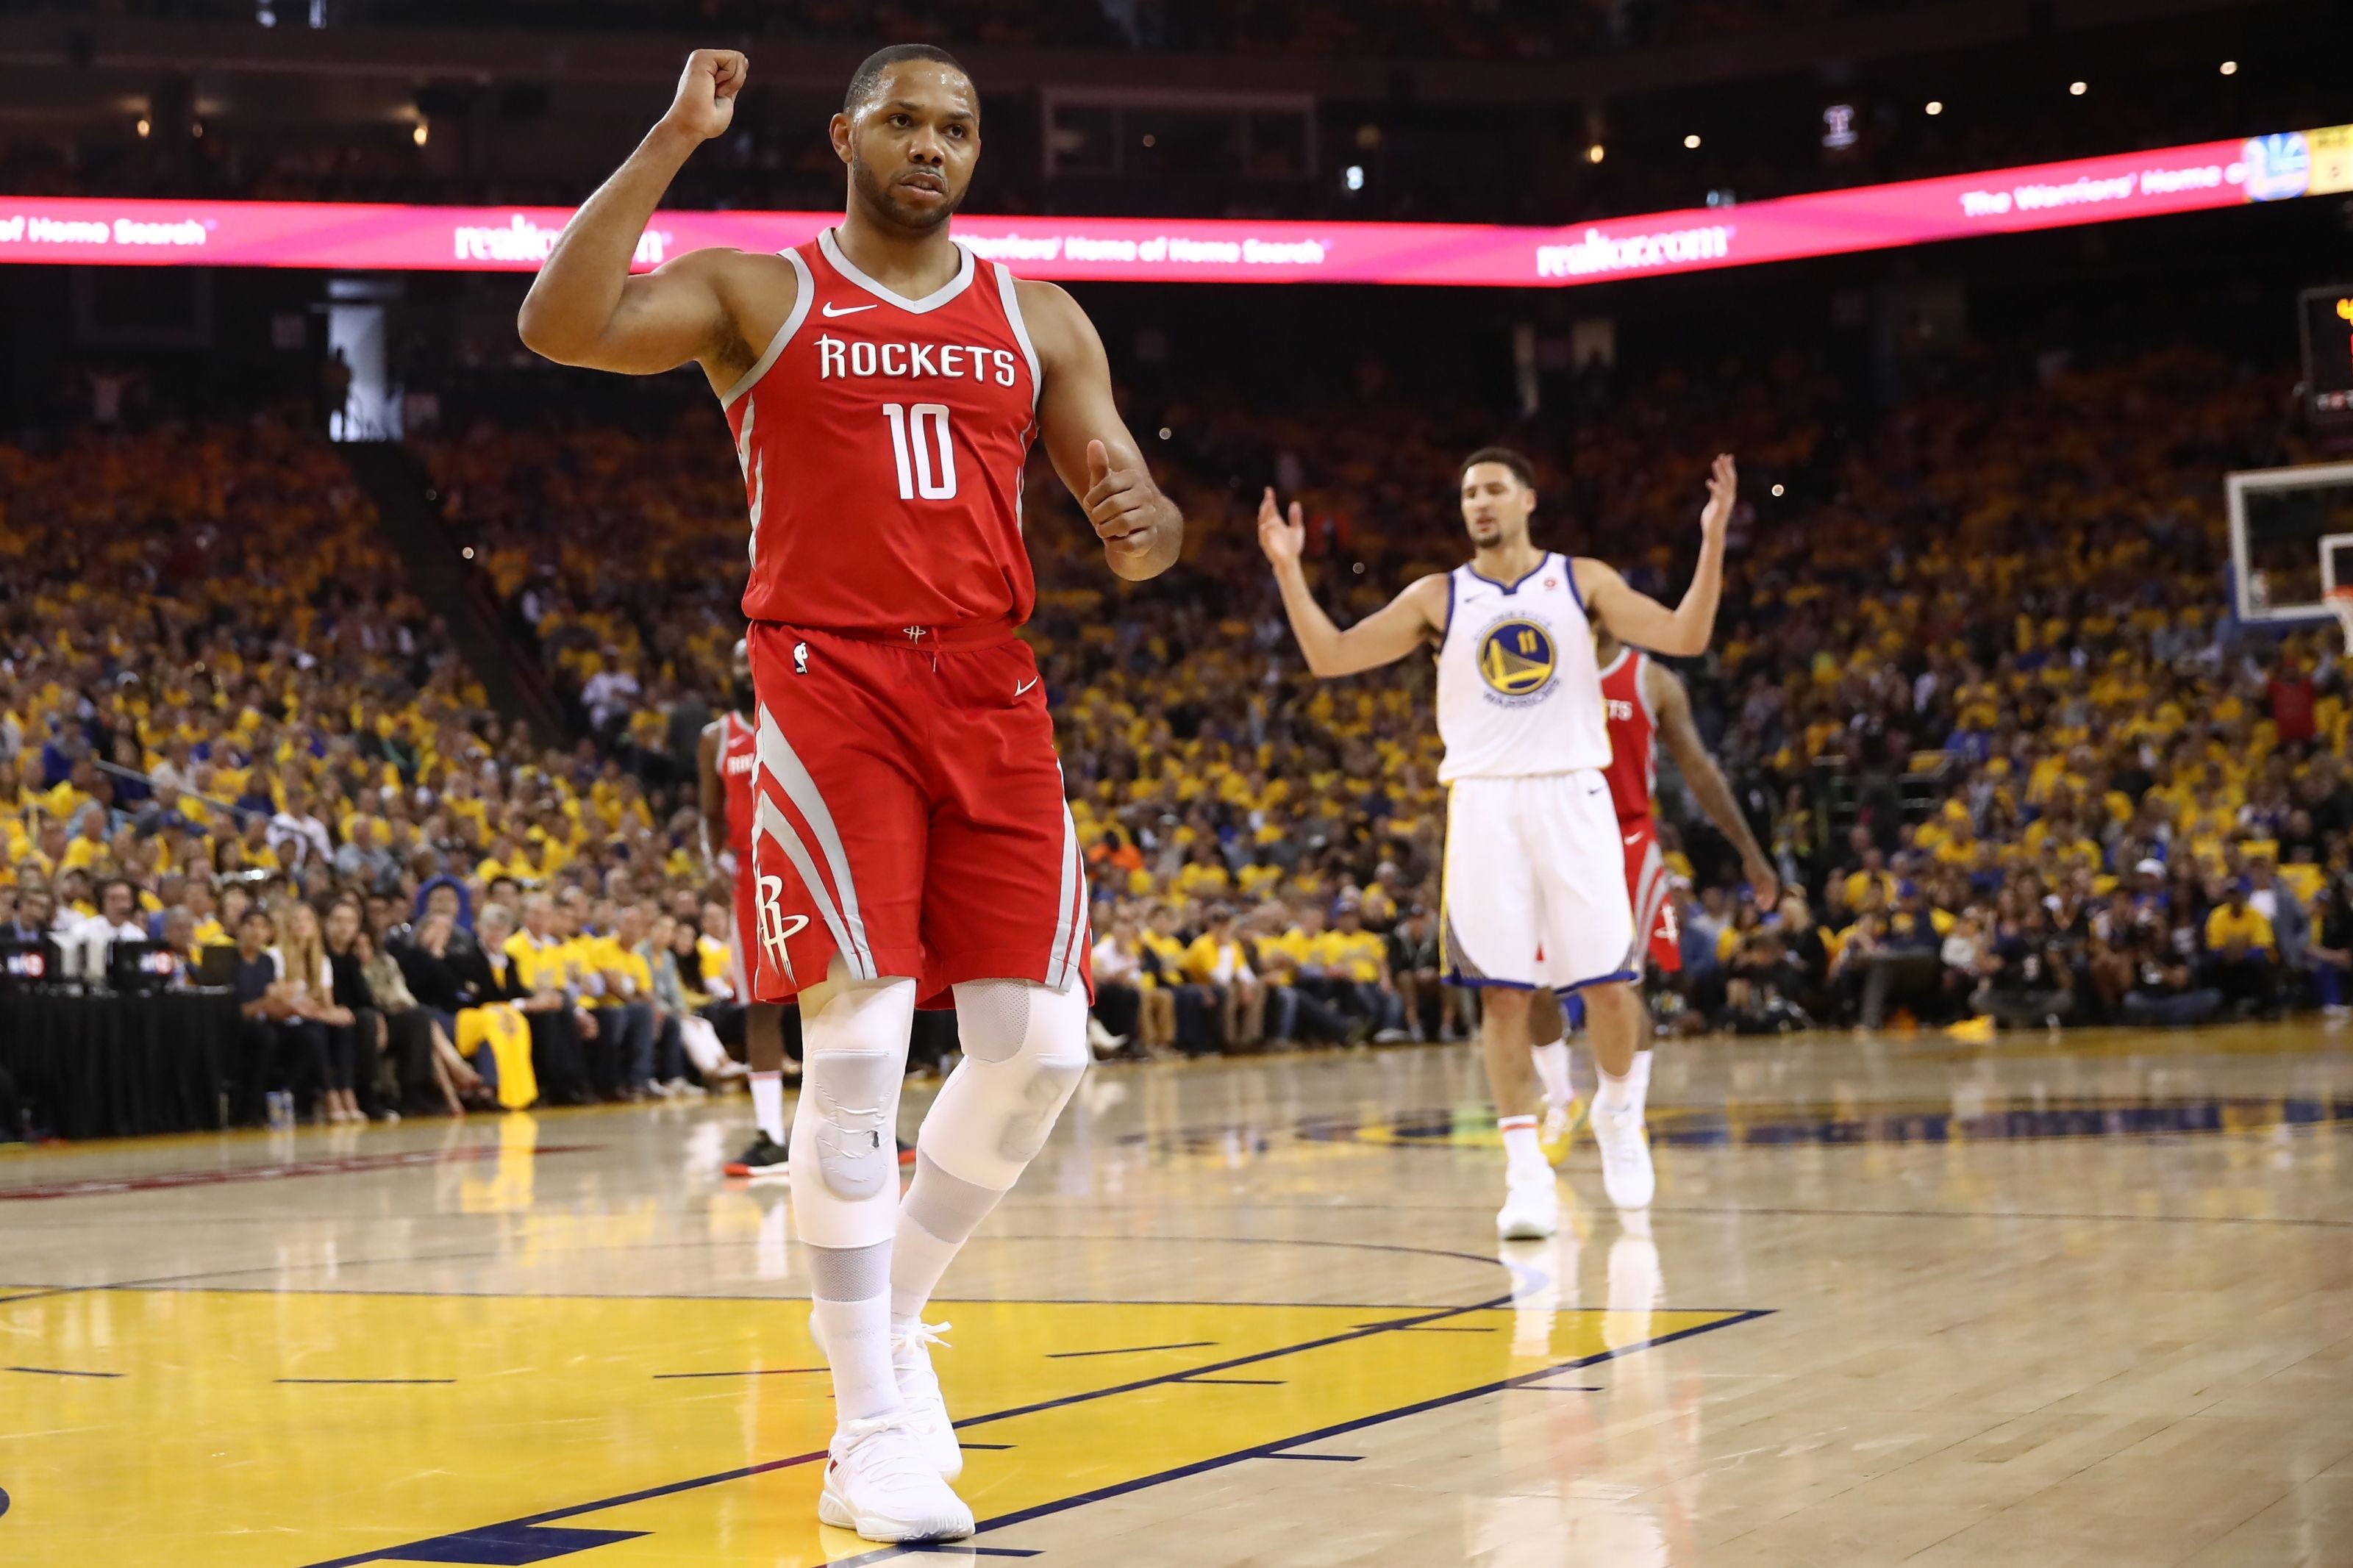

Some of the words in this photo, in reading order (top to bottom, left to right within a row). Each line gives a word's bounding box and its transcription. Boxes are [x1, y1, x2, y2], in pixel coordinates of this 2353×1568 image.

[1961, 191, 2011, 216] The
[2140, 166, 2222, 196] Home
[29, 217, 110, 243] Home
[113, 218, 206, 245] Search
[1065, 237, 1136, 261] Home
[1138, 237, 1167, 262] of
[1169, 237, 1240, 263] Home
[1243, 239, 1323, 263] Search
[814, 333, 1015, 387] ROCKETS
[882, 403, 957, 500] 10
[1517, 629, 1538, 655] 11
